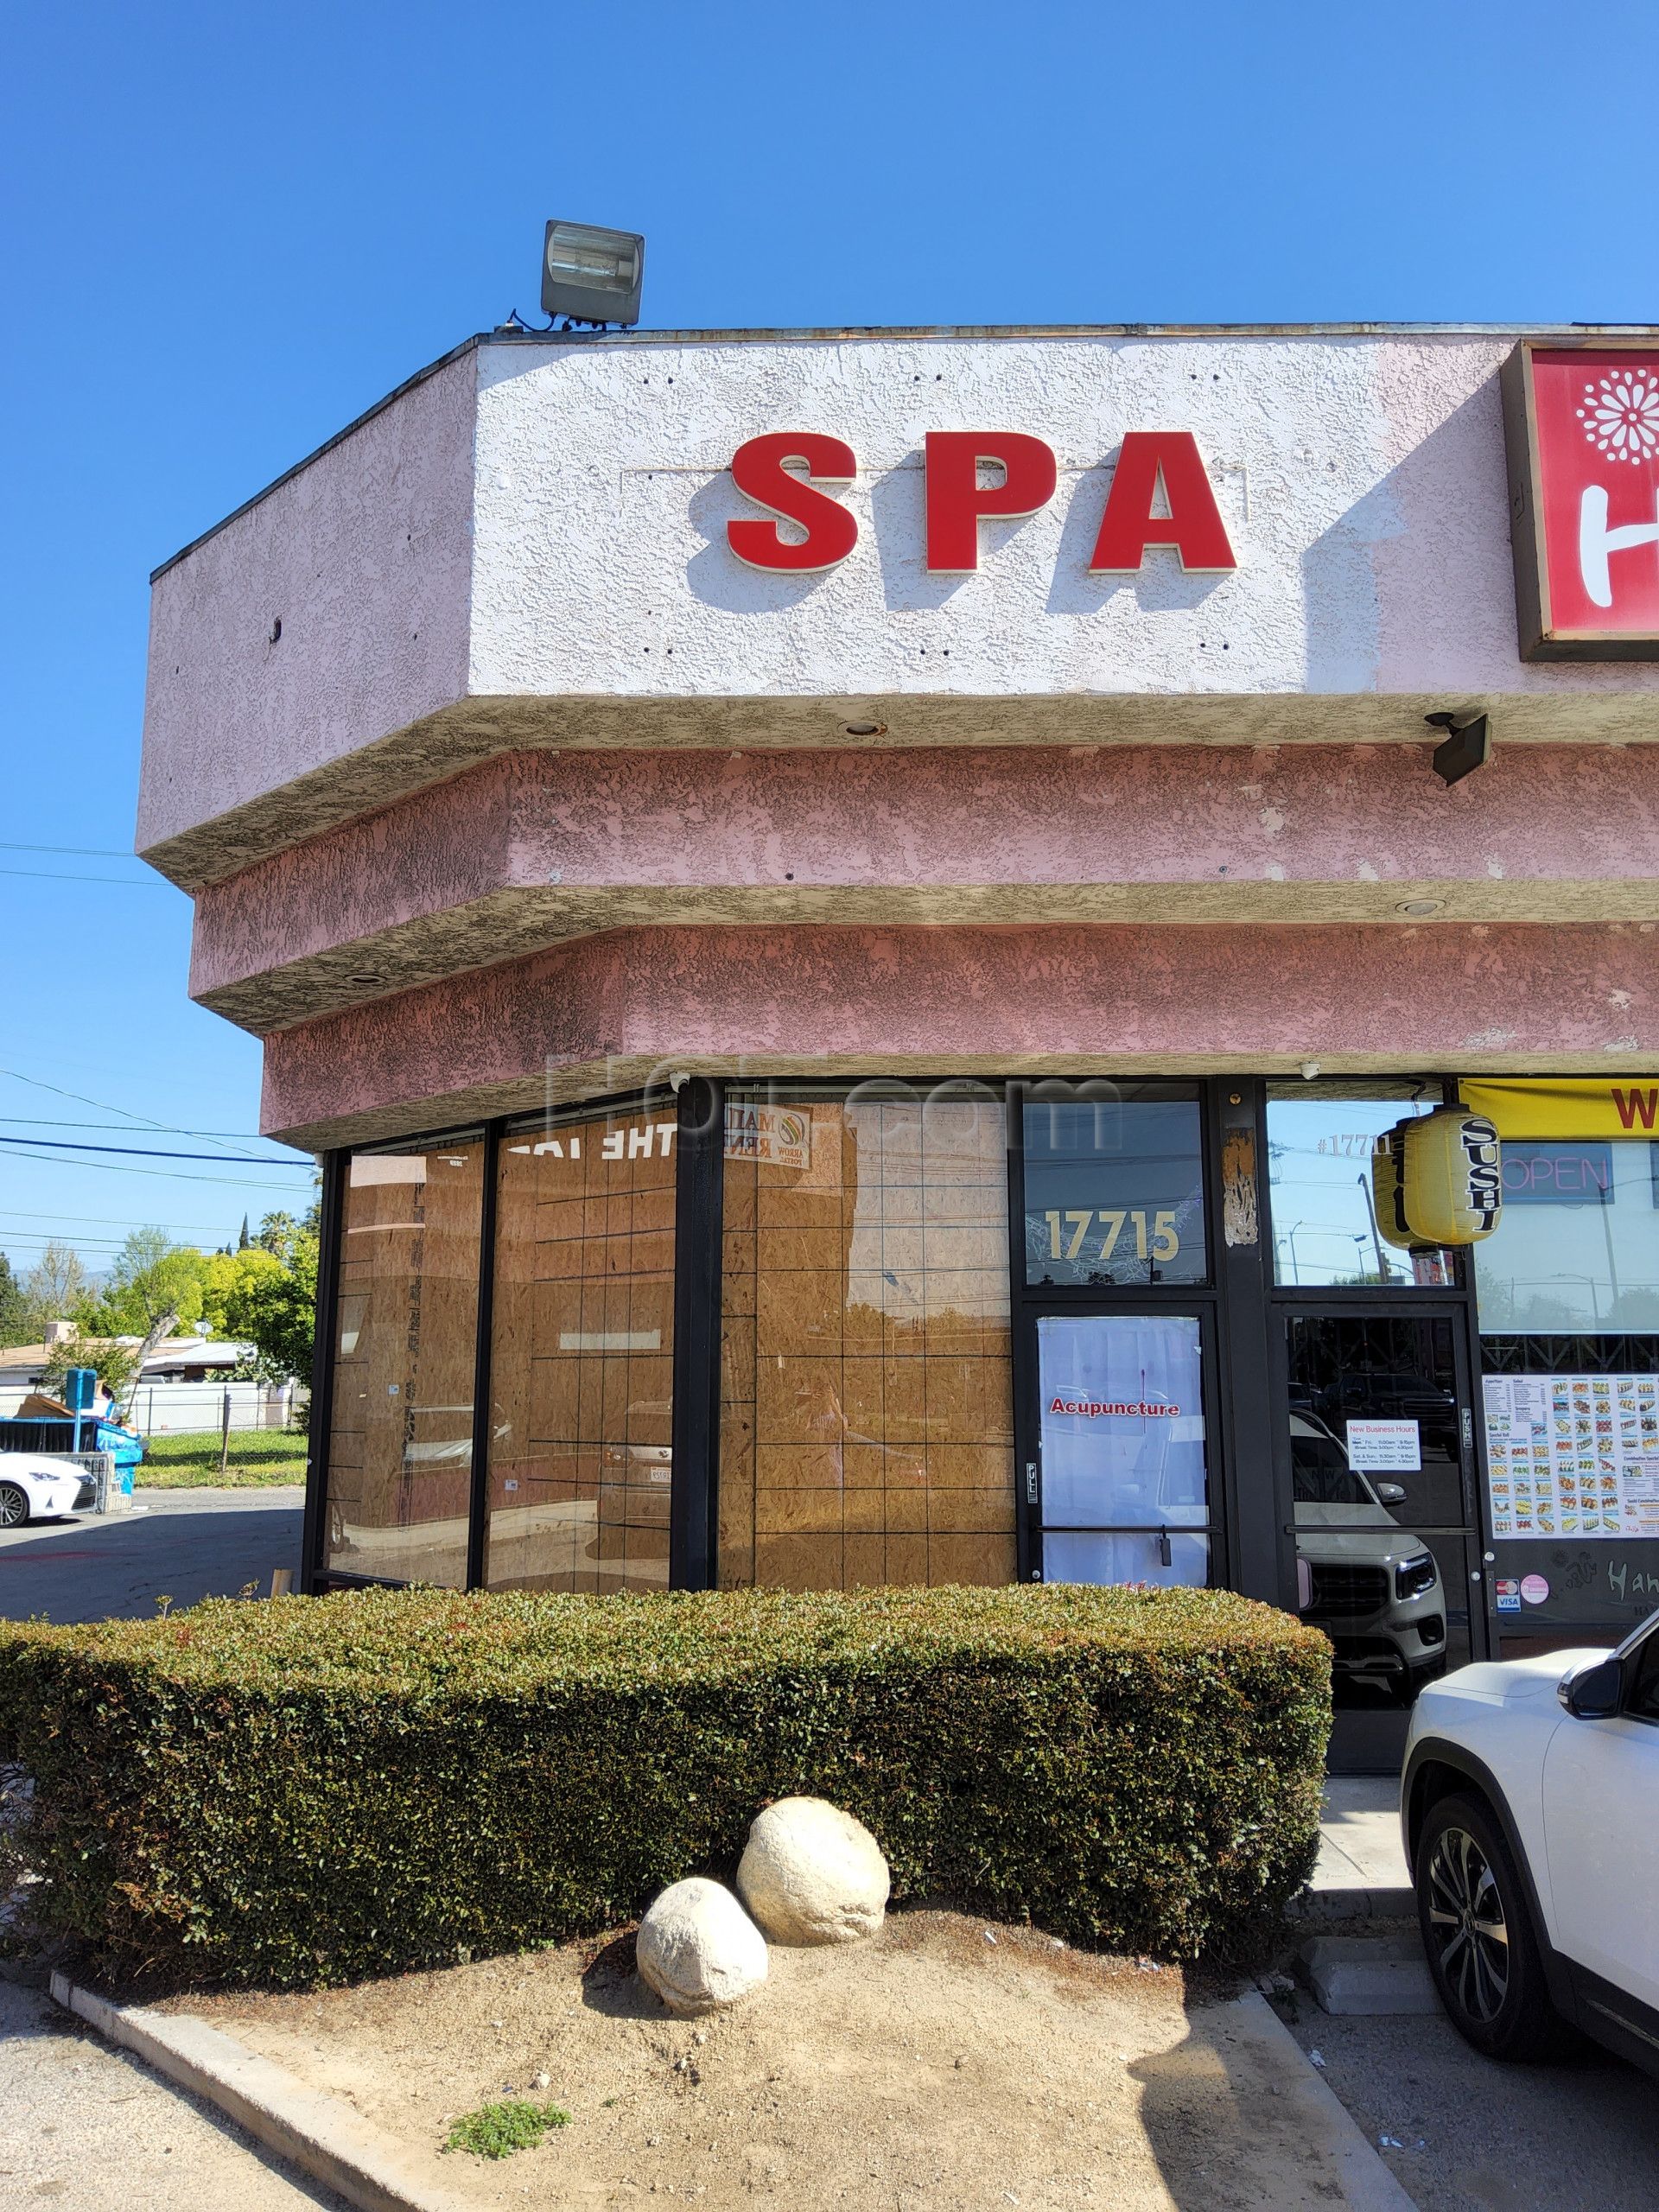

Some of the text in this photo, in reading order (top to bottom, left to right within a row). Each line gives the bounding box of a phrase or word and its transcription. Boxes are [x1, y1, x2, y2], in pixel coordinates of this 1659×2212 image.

[727, 430, 1238, 575] SPA
[1318, 1134, 1394, 1156] #17711
[1460, 1117, 1501, 1233] SUSHI
[1501, 1157, 1609, 1190] OPEN
[1046, 1210, 1180, 1262] 17715
[1050, 1397, 1182, 1419] Acupuncture
[1350, 1425, 1416, 1433] New Business Hours
